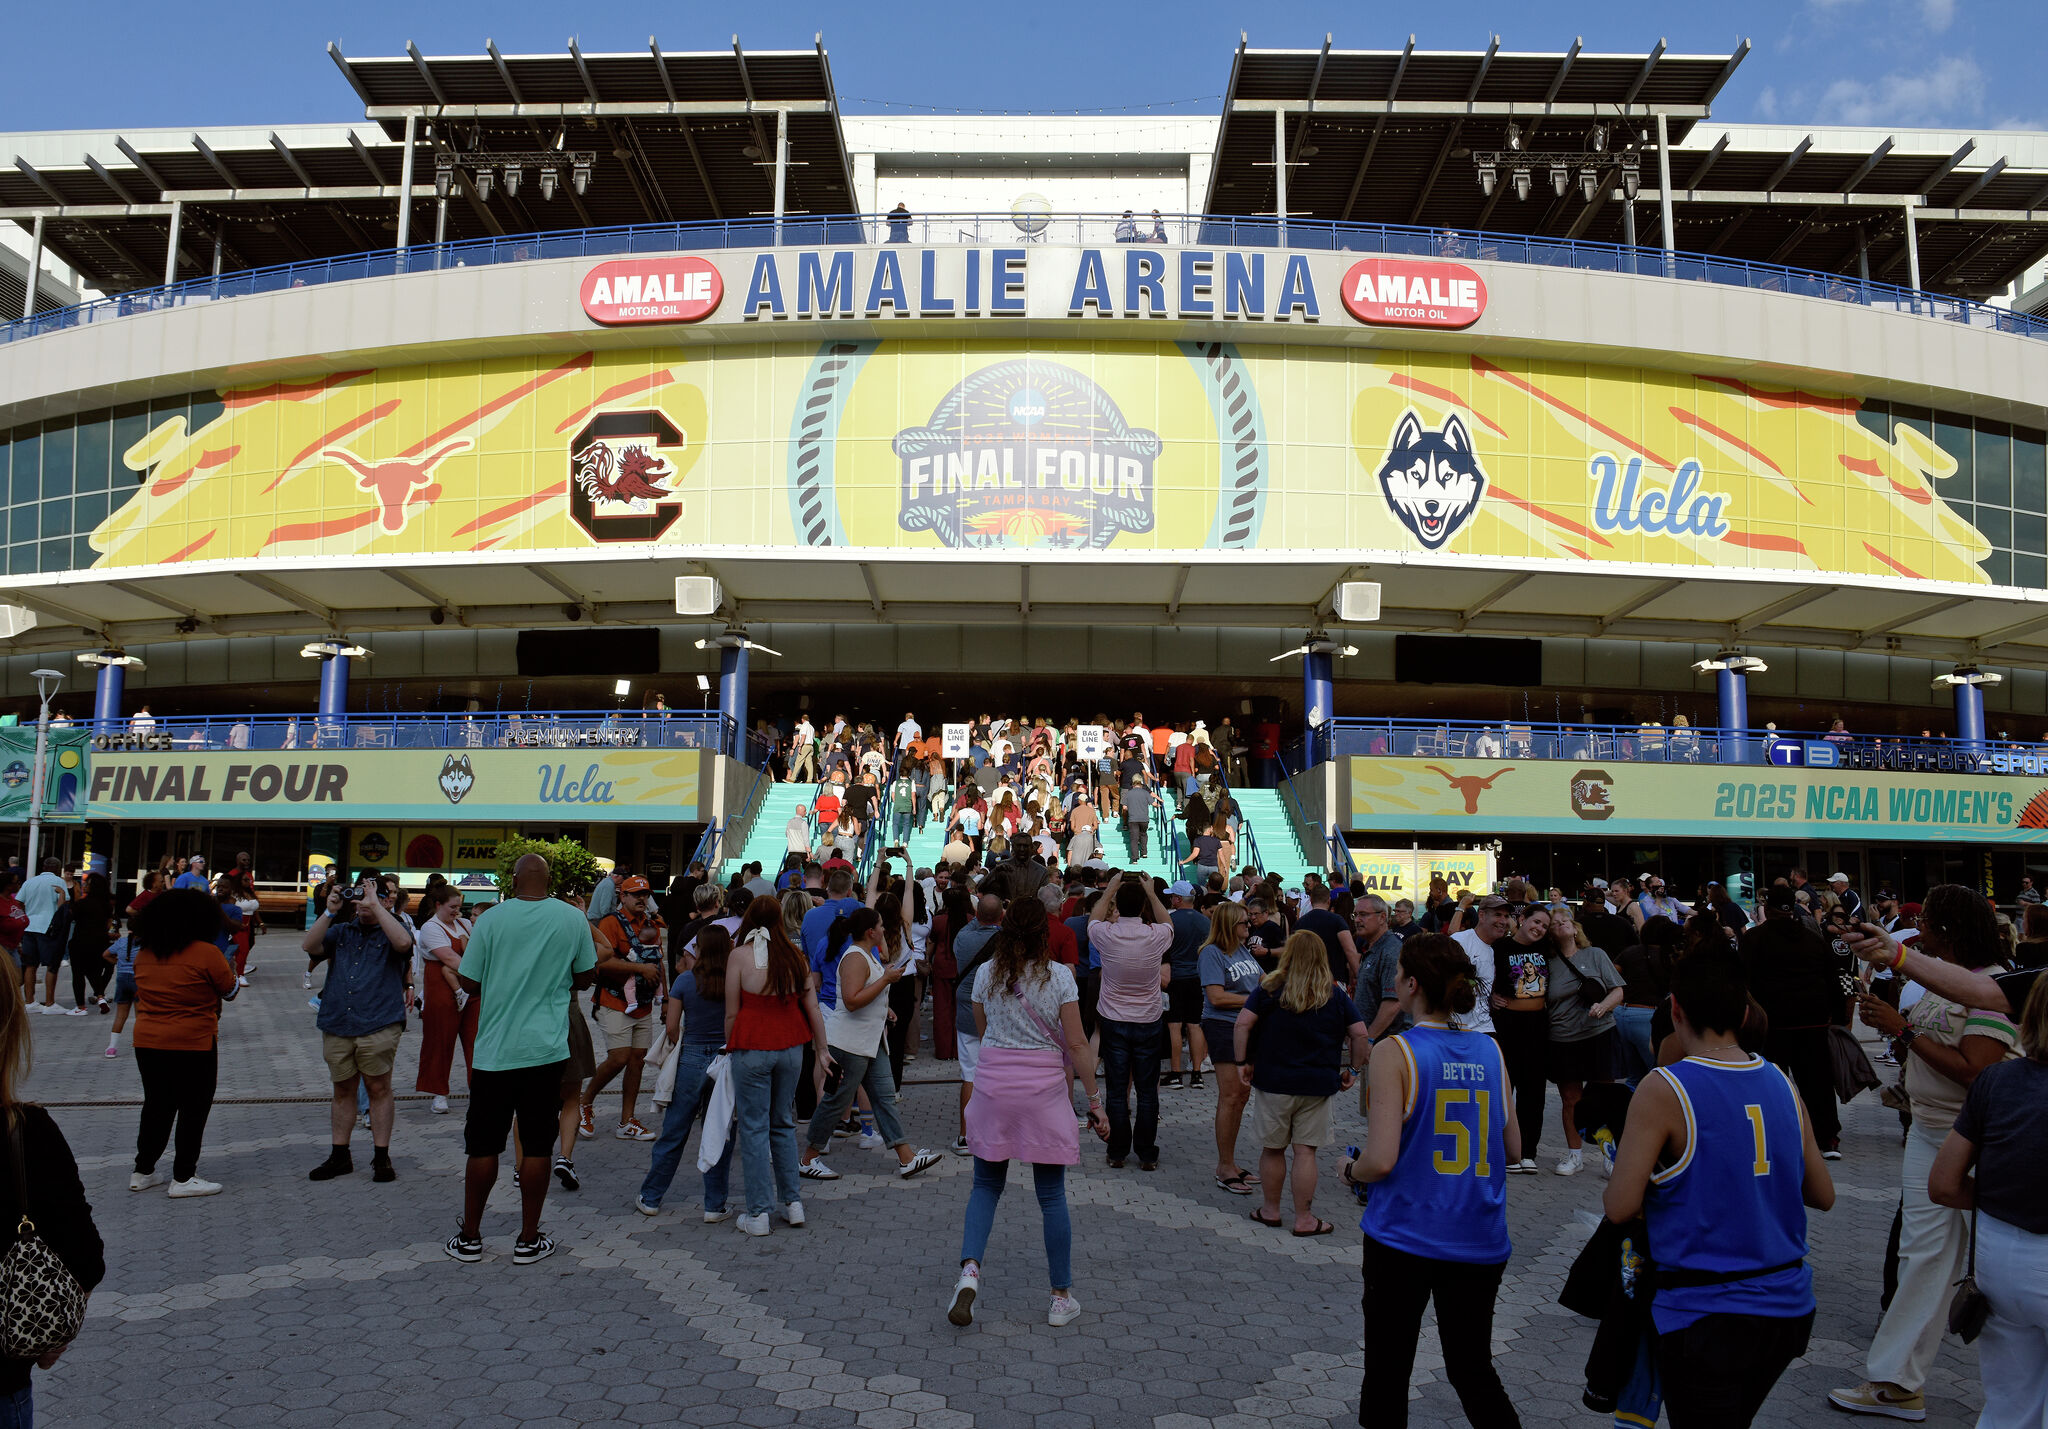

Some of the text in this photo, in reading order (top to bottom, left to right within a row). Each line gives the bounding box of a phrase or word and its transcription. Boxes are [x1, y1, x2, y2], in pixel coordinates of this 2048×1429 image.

[589, 271, 711, 306] AMALIE
[742, 249, 1321, 320] AMALIE ARENA
[1353, 273, 1478, 309] AMALIE
[618, 305, 680, 318] MOTOR OIL
[1384, 306, 1448, 320] MOTOR OIL
[1012, 405, 1045, 417] NCAA
[909, 448, 1145, 502] FINAL FOUR
[982, 495, 1072, 507] TAMPA BAY
[94, 732, 172, 750] OFFICE
[504, 727, 640, 745] PREMIUM ENTRY
[947, 728, 965, 736] BAG
[1843, 748, 1930, 770] TAMPA
[1937, 751, 1987, 771] BAY
[89, 764, 349, 802] FINAL FOUR
[899, 787, 907, 797] 4
[1714, 782, 2013, 825] 2025 NCAA WOMEN'S
[457, 838, 499, 846] WELCOME
[456, 846, 497, 860] FANS
[1359, 863, 1401, 875] FOUR
[1429, 861, 1475, 872] TAMPA
[1983, 851, 1996, 898] TAMPA
[1442, 1062, 1485, 1082] BETTS
[1432, 1088, 1491, 1177] 51
[1744, 1104, 1771, 1177] 1
